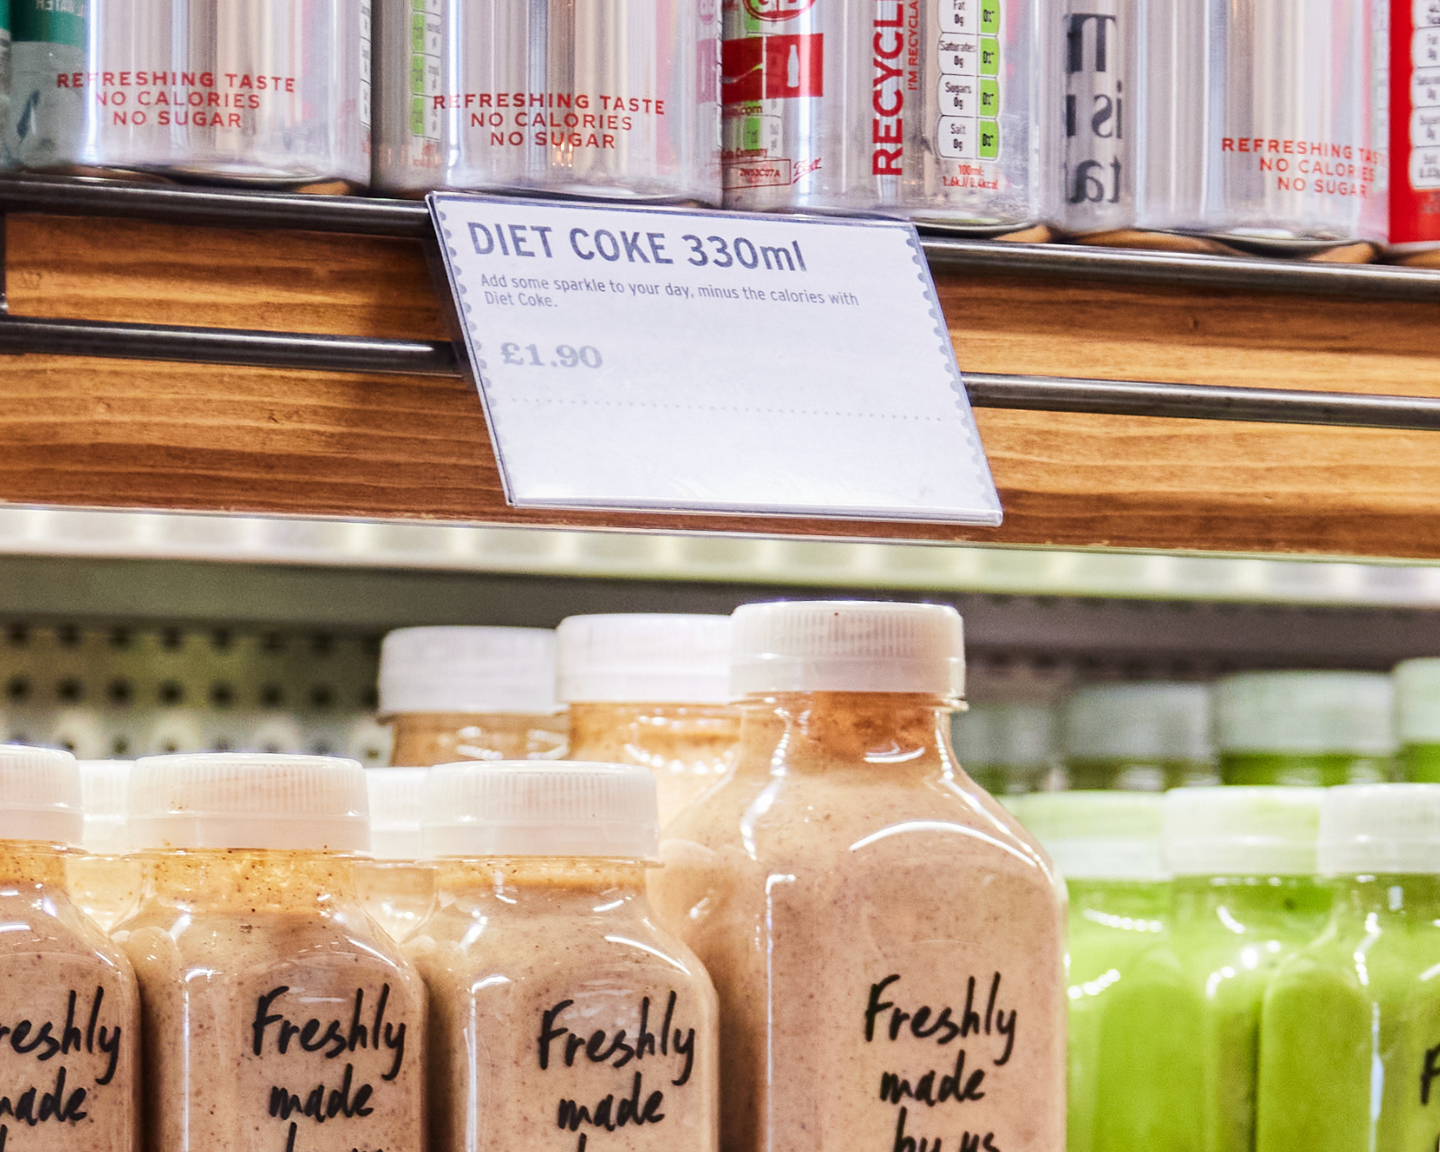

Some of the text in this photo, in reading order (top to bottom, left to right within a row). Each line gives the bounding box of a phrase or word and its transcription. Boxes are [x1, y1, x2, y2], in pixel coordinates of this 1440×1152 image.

[57, 71, 296, 93] REFRESHING TASTE
[96, 91, 260, 109] NO CALORIES
[434, 93, 665, 115] REFRESHING TASTE
[114, 111, 242, 128] NO SUGAR
[471, 112, 632, 131] NO CALORIES
[490, 131, 615, 149] NO SUGAR
[1222, 137, 1353, 160] REFRESHING
[1259, 157, 1289, 172] NO
[1277, 176, 1306, 191] NO
[467, 221, 807, 272] DIET COKE 330ml
[481, 273, 859, 306] Add some sparkle to your day, minus the calories with
[484, 291, 558, 307] Diet Coke.
[500, 341, 604, 369] £1.90
[864, 971, 1017, 1066] Freshly
[253, 984, 406, 1081] Freshly
[537, 990, 695, 1086] Freshly
[880, 1049, 986, 1106] made
[269, 1063, 374, 1123] made
[558, 1071, 666, 1132] made
